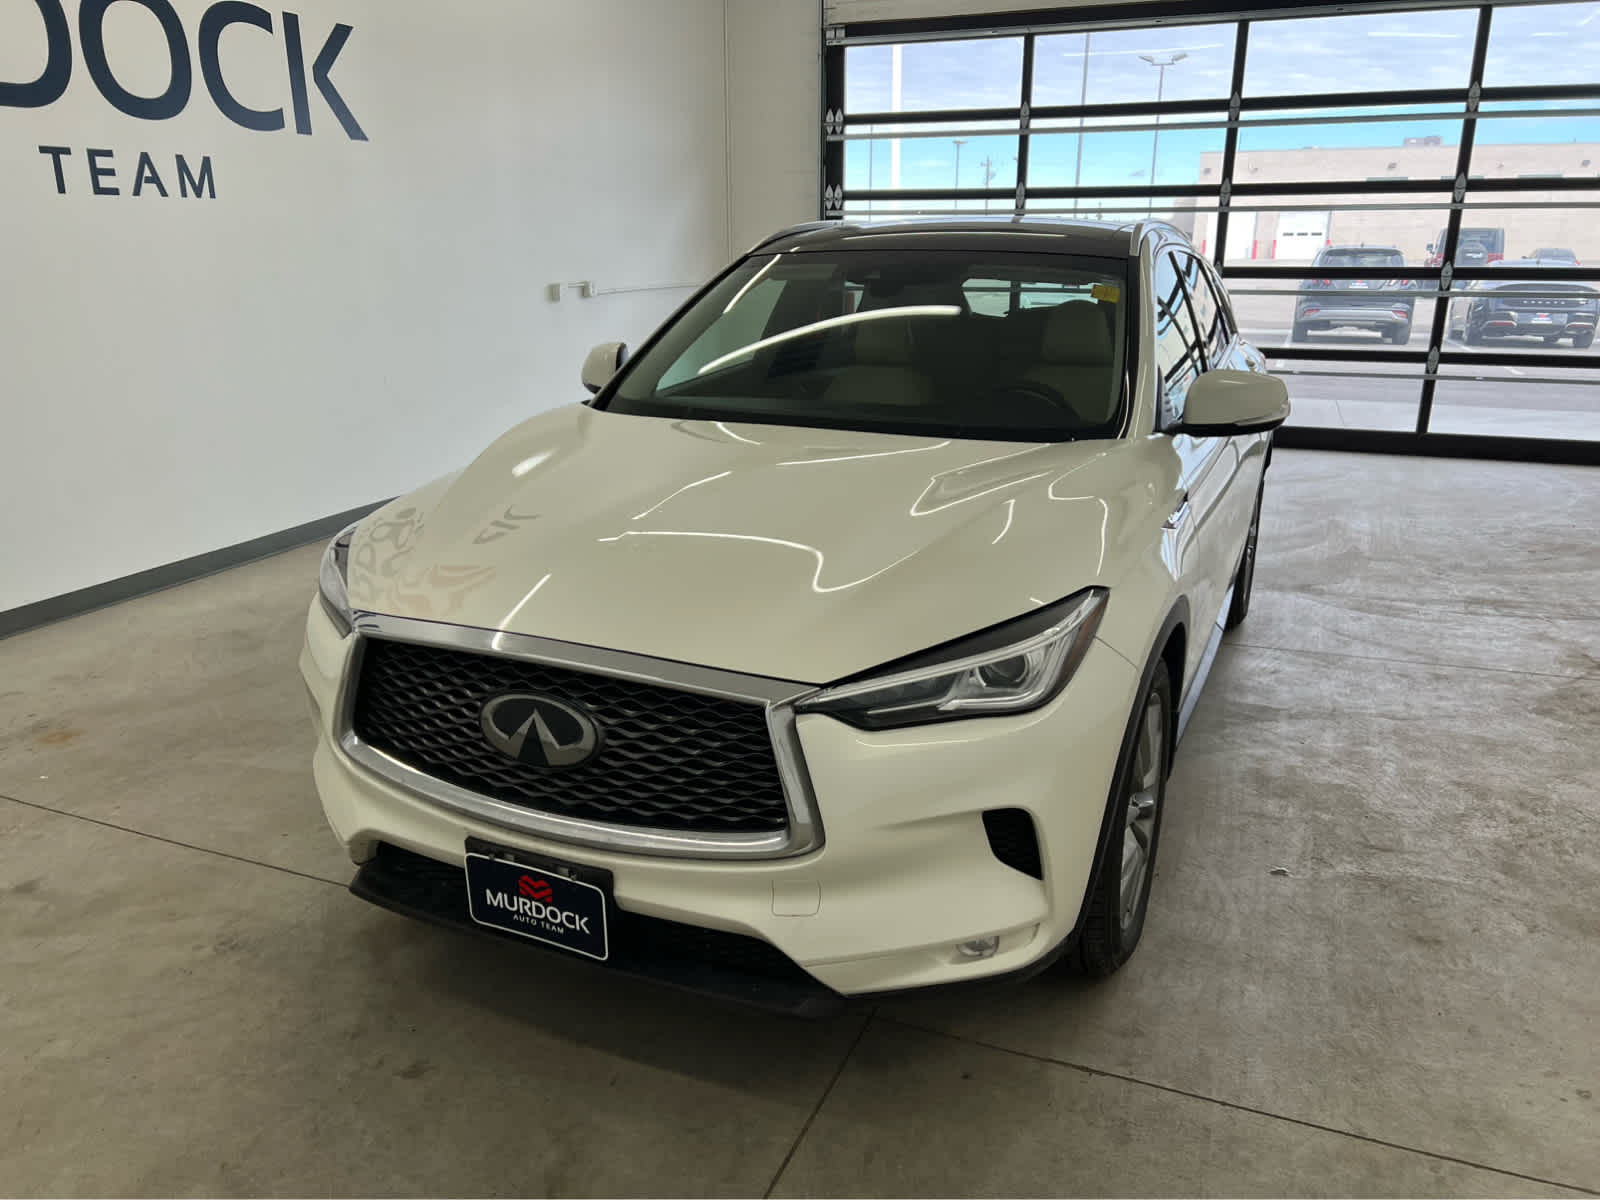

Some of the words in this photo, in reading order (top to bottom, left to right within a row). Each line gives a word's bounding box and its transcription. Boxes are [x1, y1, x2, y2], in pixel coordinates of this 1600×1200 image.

[38, 145, 216, 199] TEAM
[485, 888, 591, 935] MURDOCK
[513, 914, 537, 926] AUTO
[541, 921, 564, 934] TEAM
